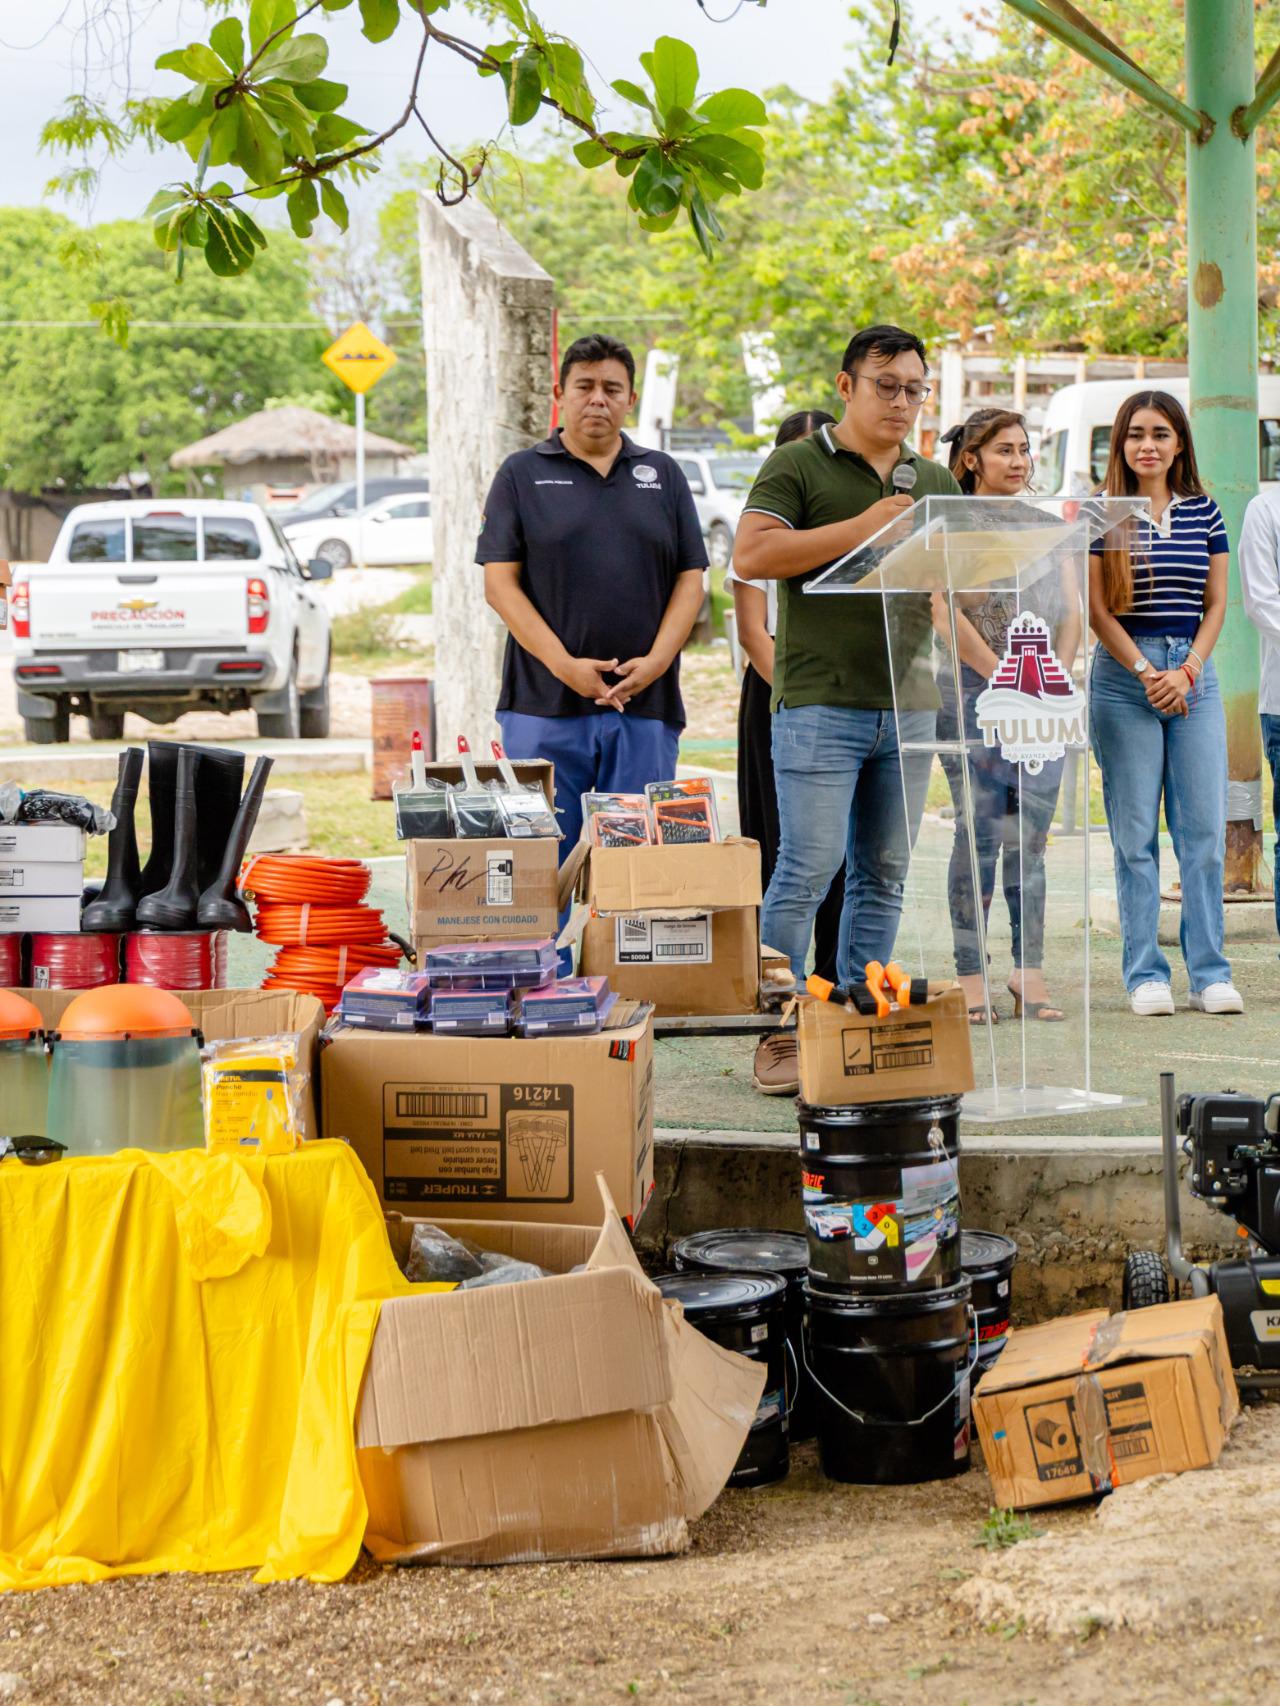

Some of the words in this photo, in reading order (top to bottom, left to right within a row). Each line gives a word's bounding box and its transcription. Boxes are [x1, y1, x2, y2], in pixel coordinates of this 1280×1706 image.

[91, 608, 186, 622] PRECAUCIÓN
[979, 718, 1084, 746] TULUM
[437, 915, 480, 925] MANEJESE
[483, 915, 500, 924] CON
[502, 914, 538, 924] CUIDADO
[513, 1086, 561, 1101] 14216
[443, 1156, 475, 1165] cinturón
[476, 1157, 498, 1165] tercer
[454, 1166, 481, 1175] lumbar
[482, 1166, 498, 1175] Faja
[424, 1183, 479, 1196] TRUPER
[873, 1211, 879, 1219] 3
[1045, 1464, 1077, 1479] 17649
